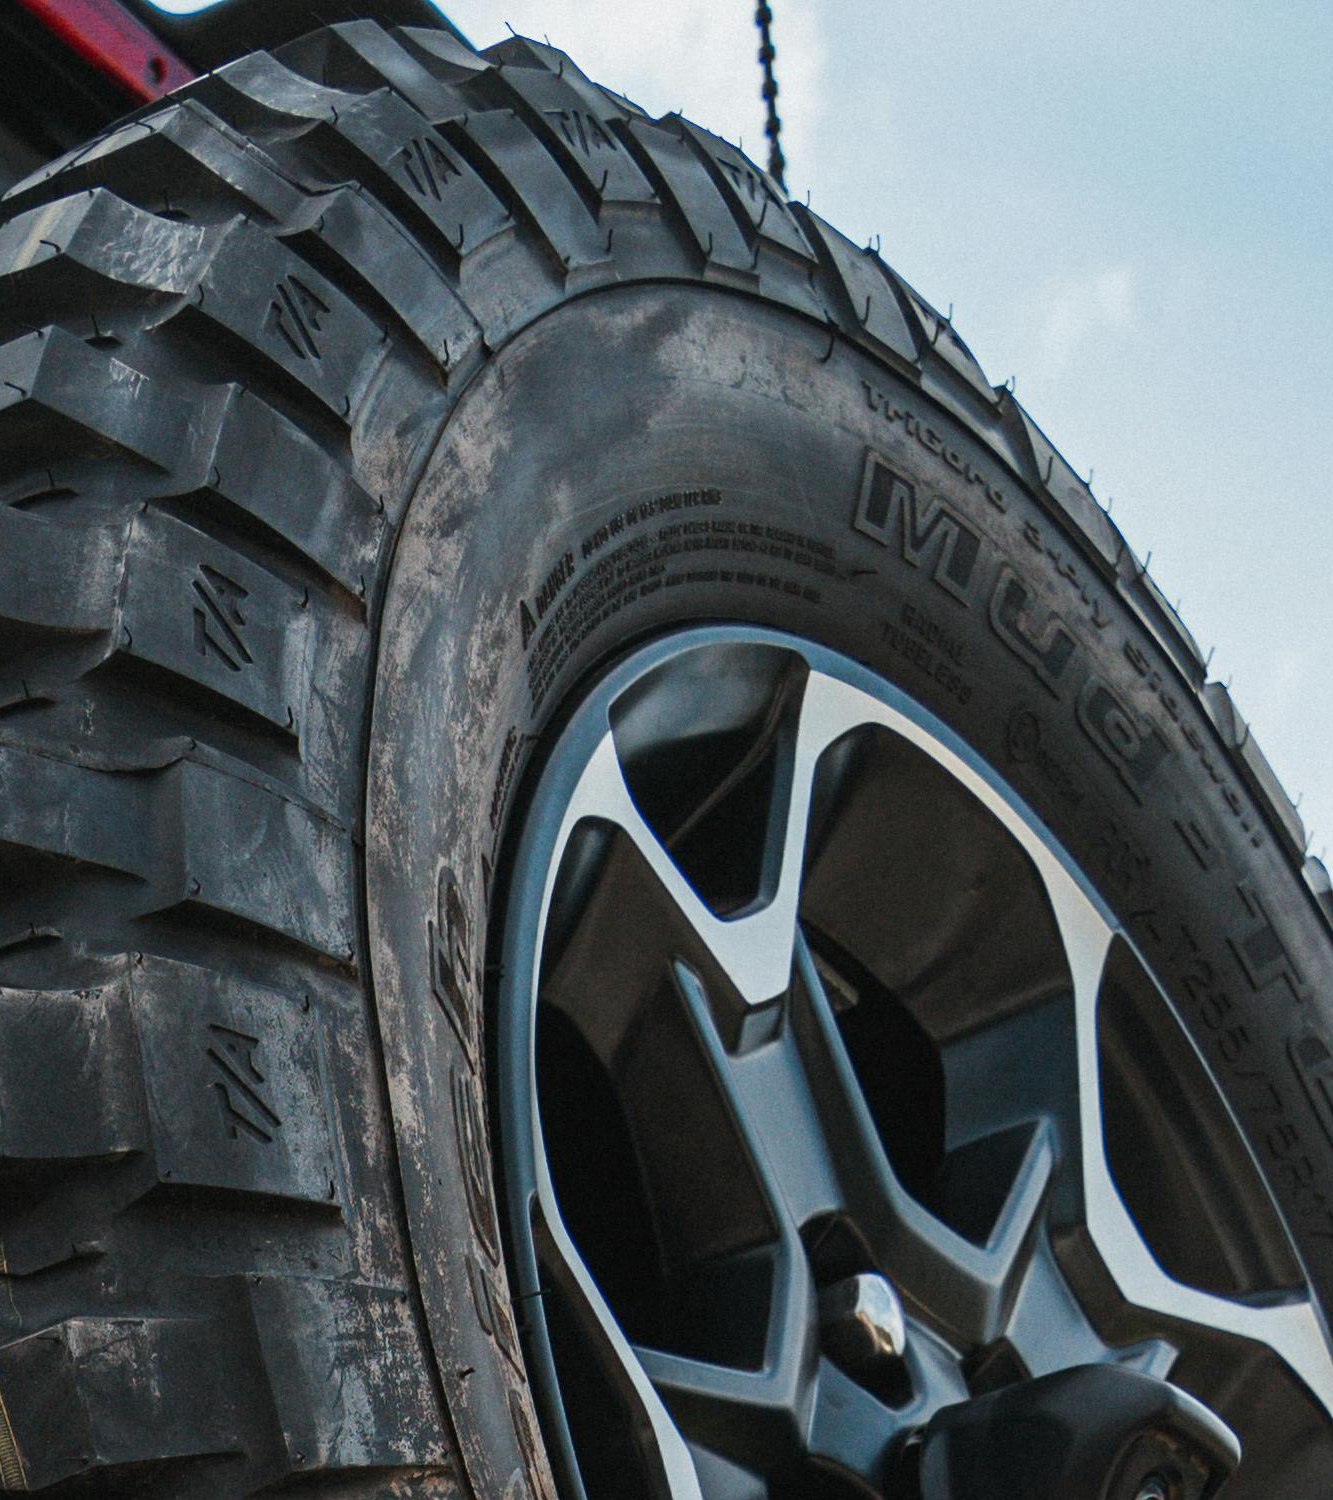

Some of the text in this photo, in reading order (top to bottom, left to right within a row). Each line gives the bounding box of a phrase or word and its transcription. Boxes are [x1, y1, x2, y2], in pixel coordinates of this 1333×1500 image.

[399, 136, 463, 201] T/A
[543, 109, 618, 157] T/A
[269, 274, 331, 361] T/A
[191, 563, 254, 673] T/A
[206, 1022, 282, 1145] T/A
